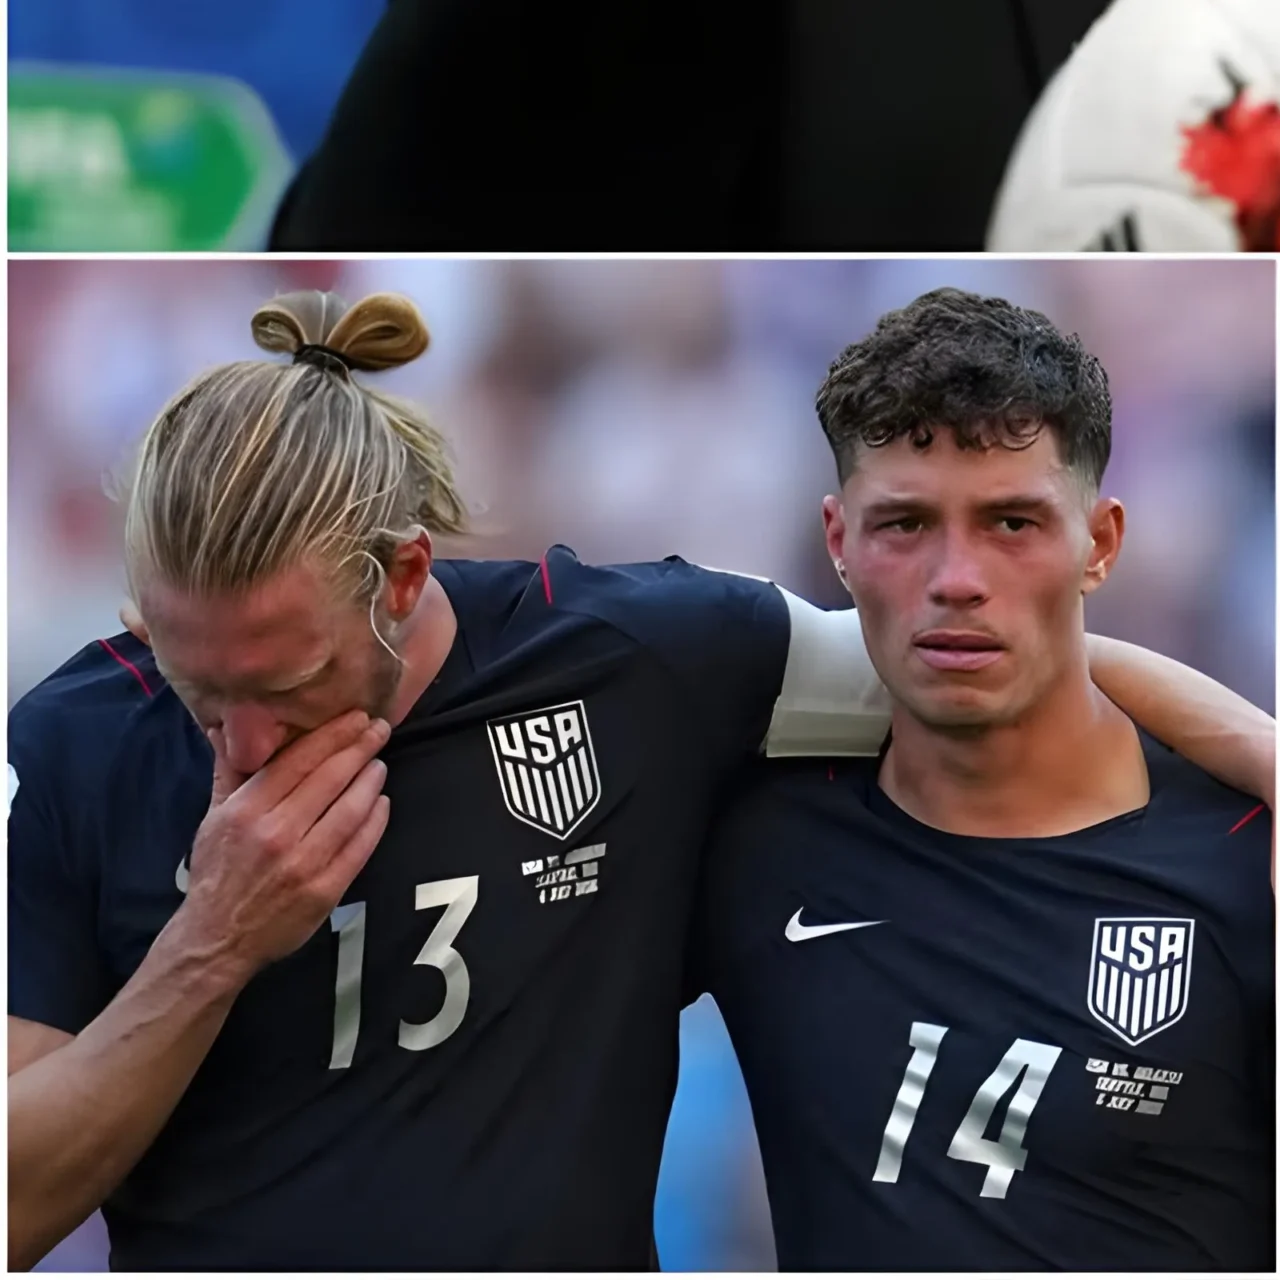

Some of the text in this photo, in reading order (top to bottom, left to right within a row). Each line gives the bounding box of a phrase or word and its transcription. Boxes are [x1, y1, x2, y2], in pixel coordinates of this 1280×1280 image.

[495, 710, 582, 764] USA
[328, 875, 480, 1070] 13
[1101, 926, 1186, 971] USA
[872, 1021, 1064, 1200] 14
